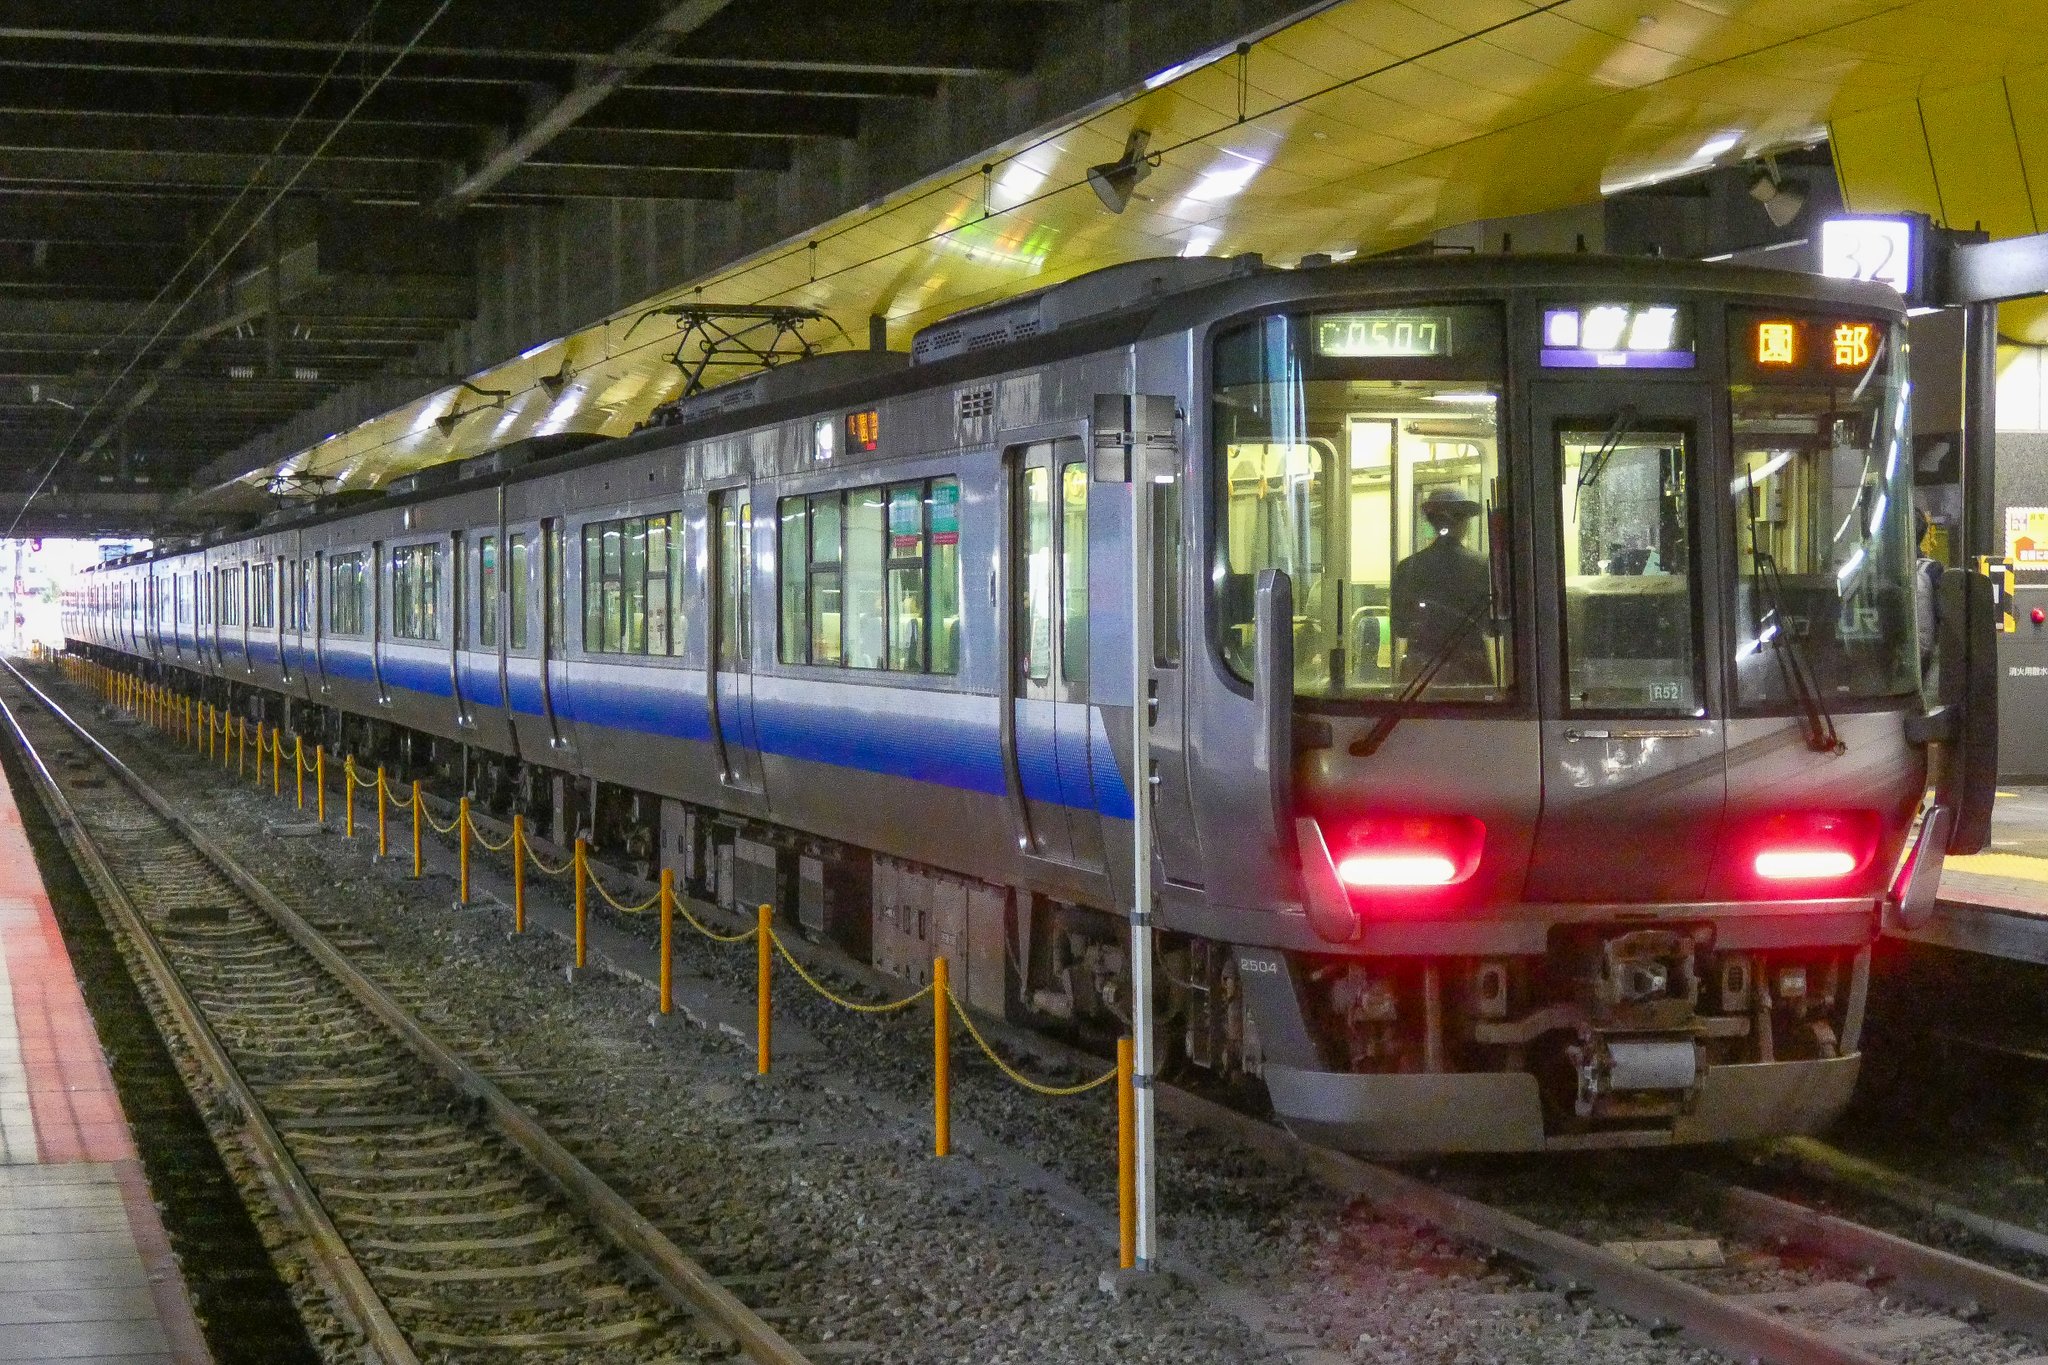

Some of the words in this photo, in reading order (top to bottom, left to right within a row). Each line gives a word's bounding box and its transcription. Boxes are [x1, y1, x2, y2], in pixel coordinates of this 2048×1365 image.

[1843, 233, 1896, 282] 32
[1838, 608, 1879, 633] JR
[1654, 685, 1679, 699] R52
[1240, 958, 1278, 974] 2504
